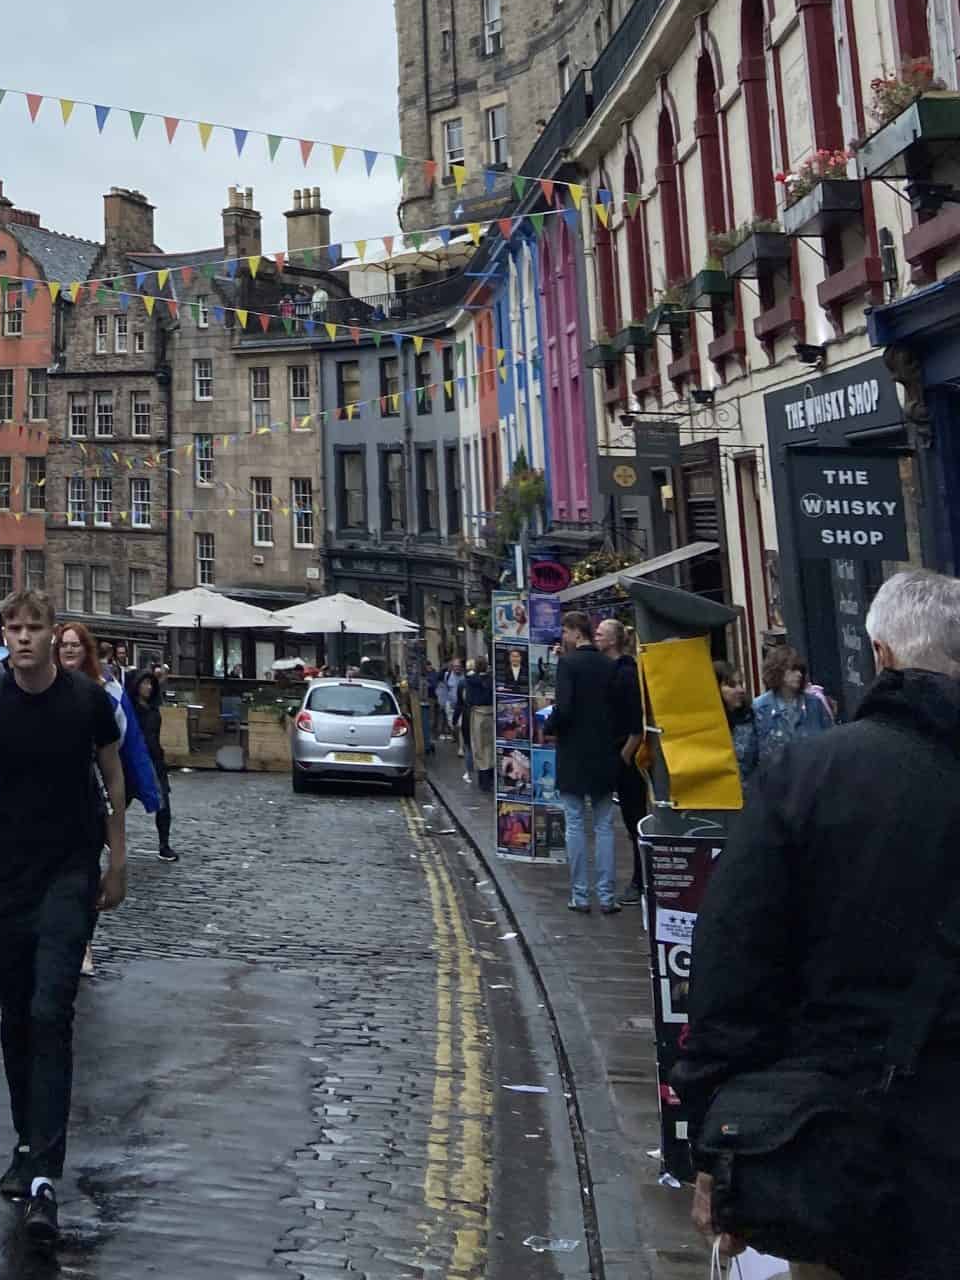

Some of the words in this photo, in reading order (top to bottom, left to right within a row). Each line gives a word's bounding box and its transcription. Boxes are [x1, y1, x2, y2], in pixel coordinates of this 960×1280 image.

[785, 401, 805, 430] THE
[804, 389, 845, 426] WHISKY
[848, 380, 879, 416] SHOP
[822, 470, 869, 485] THE
[802, 497, 897, 516] WHISKY
[821, 529, 883, 545] SHOP
